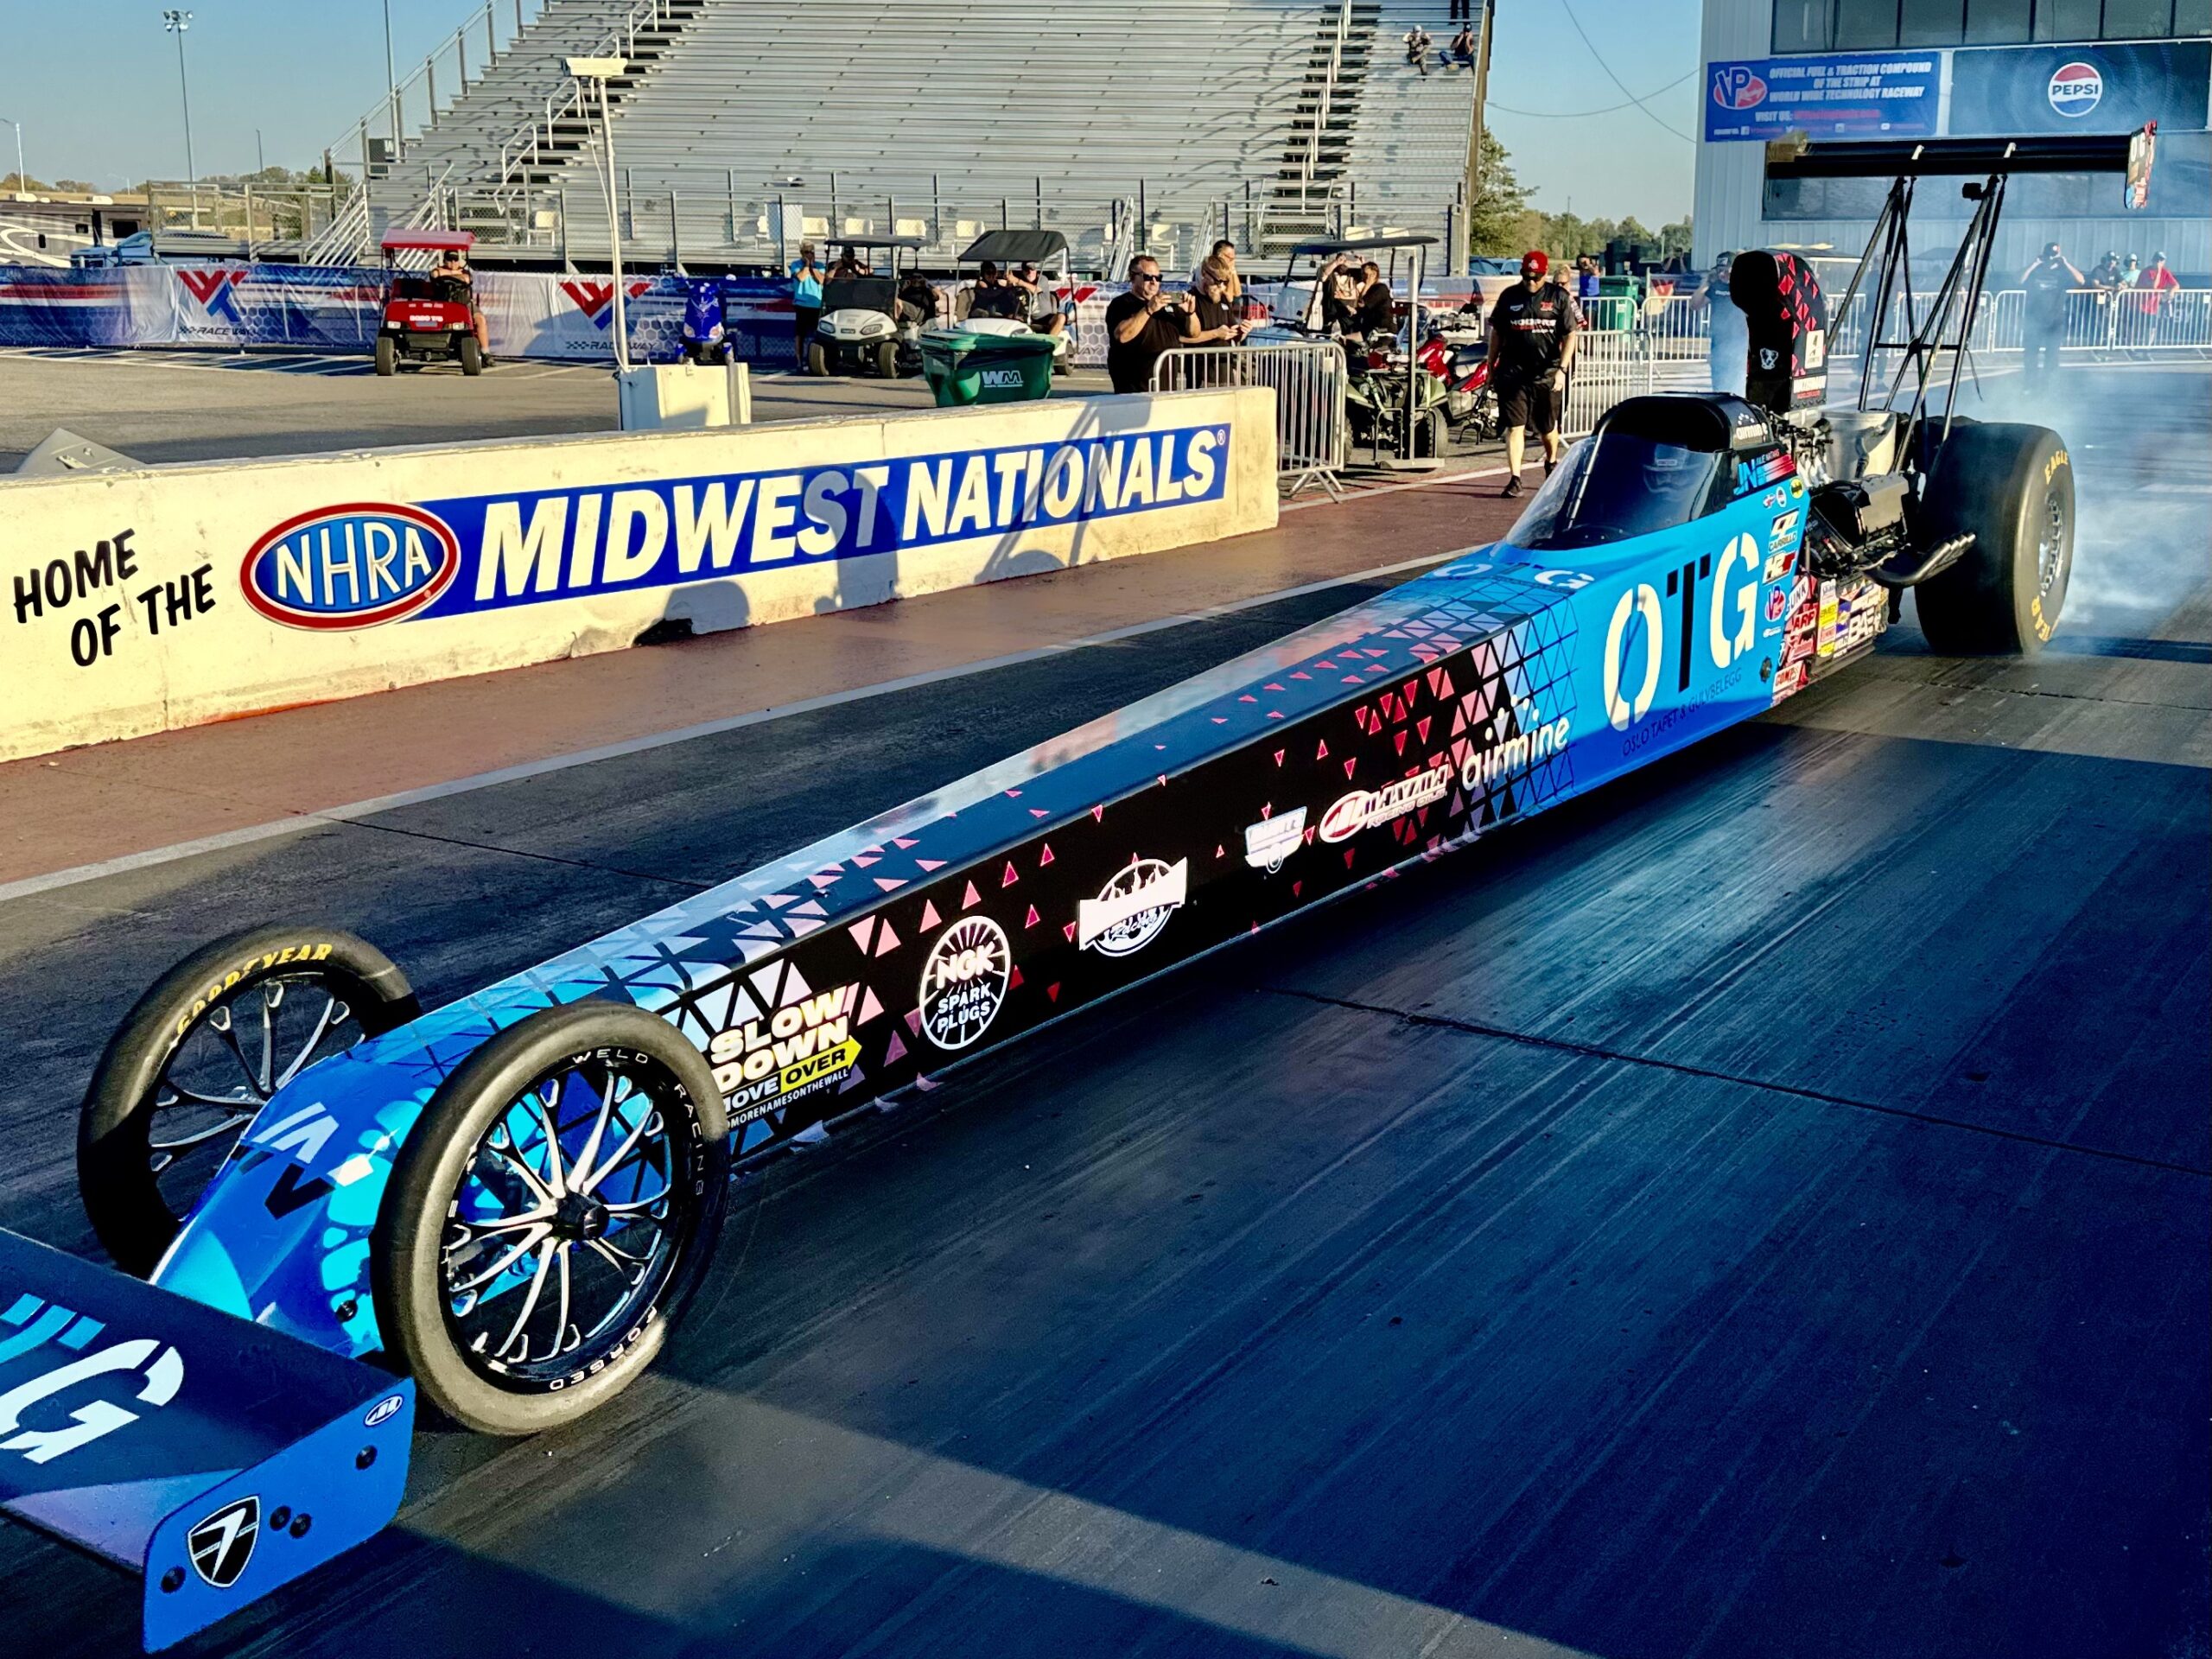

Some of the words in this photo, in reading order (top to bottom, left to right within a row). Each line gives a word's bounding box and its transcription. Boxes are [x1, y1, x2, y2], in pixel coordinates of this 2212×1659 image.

[1770, 67, 1806, 79] OFFICIAL
[1836, 64, 1879, 76] TRACTION
[1880, 62, 1931, 74] COMPOUND
[1825, 88, 1881, 100] TECHNOLOGY
[1881, 86, 1925, 99] RACEWAY
[2052, 84, 2099, 95] PEPSI
[1755, 111, 1777, 122] VISIT
[982, 370, 1023, 384] WM
[2045, 449, 2068, 485] EAGLE
[474, 465, 890, 601] MIDWEST
[13, 529, 138, 624] HOME
[276, 522, 432, 606] NHRA
[71, 604, 121, 667] OF
[137, 563, 216, 635] THE
[1604, 532, 1760, 732] OTG
[1623, 727, 1649, 757] OSLO
[1651, 709, 1679, 738] TAPET
[1688, 668, 1742, 713] GULVBELEGG
[1462, 717, 1570, 791] airmine
[936, 941, 995, 989] NGK
[710, 986, 848, 1064] SLOW
[937, 1001, 990, 1033] PLUGS
[938, 982, 991, 1014] SPARK
[573, 1049, 648, 1064] WELD
[711, 1015, 849, 1093] DOWN
[785, 1048, 846, 1084] OVER
[674, 1084, 704, 1195] RACING
[550, 1306, 658, 1390] FORGED
